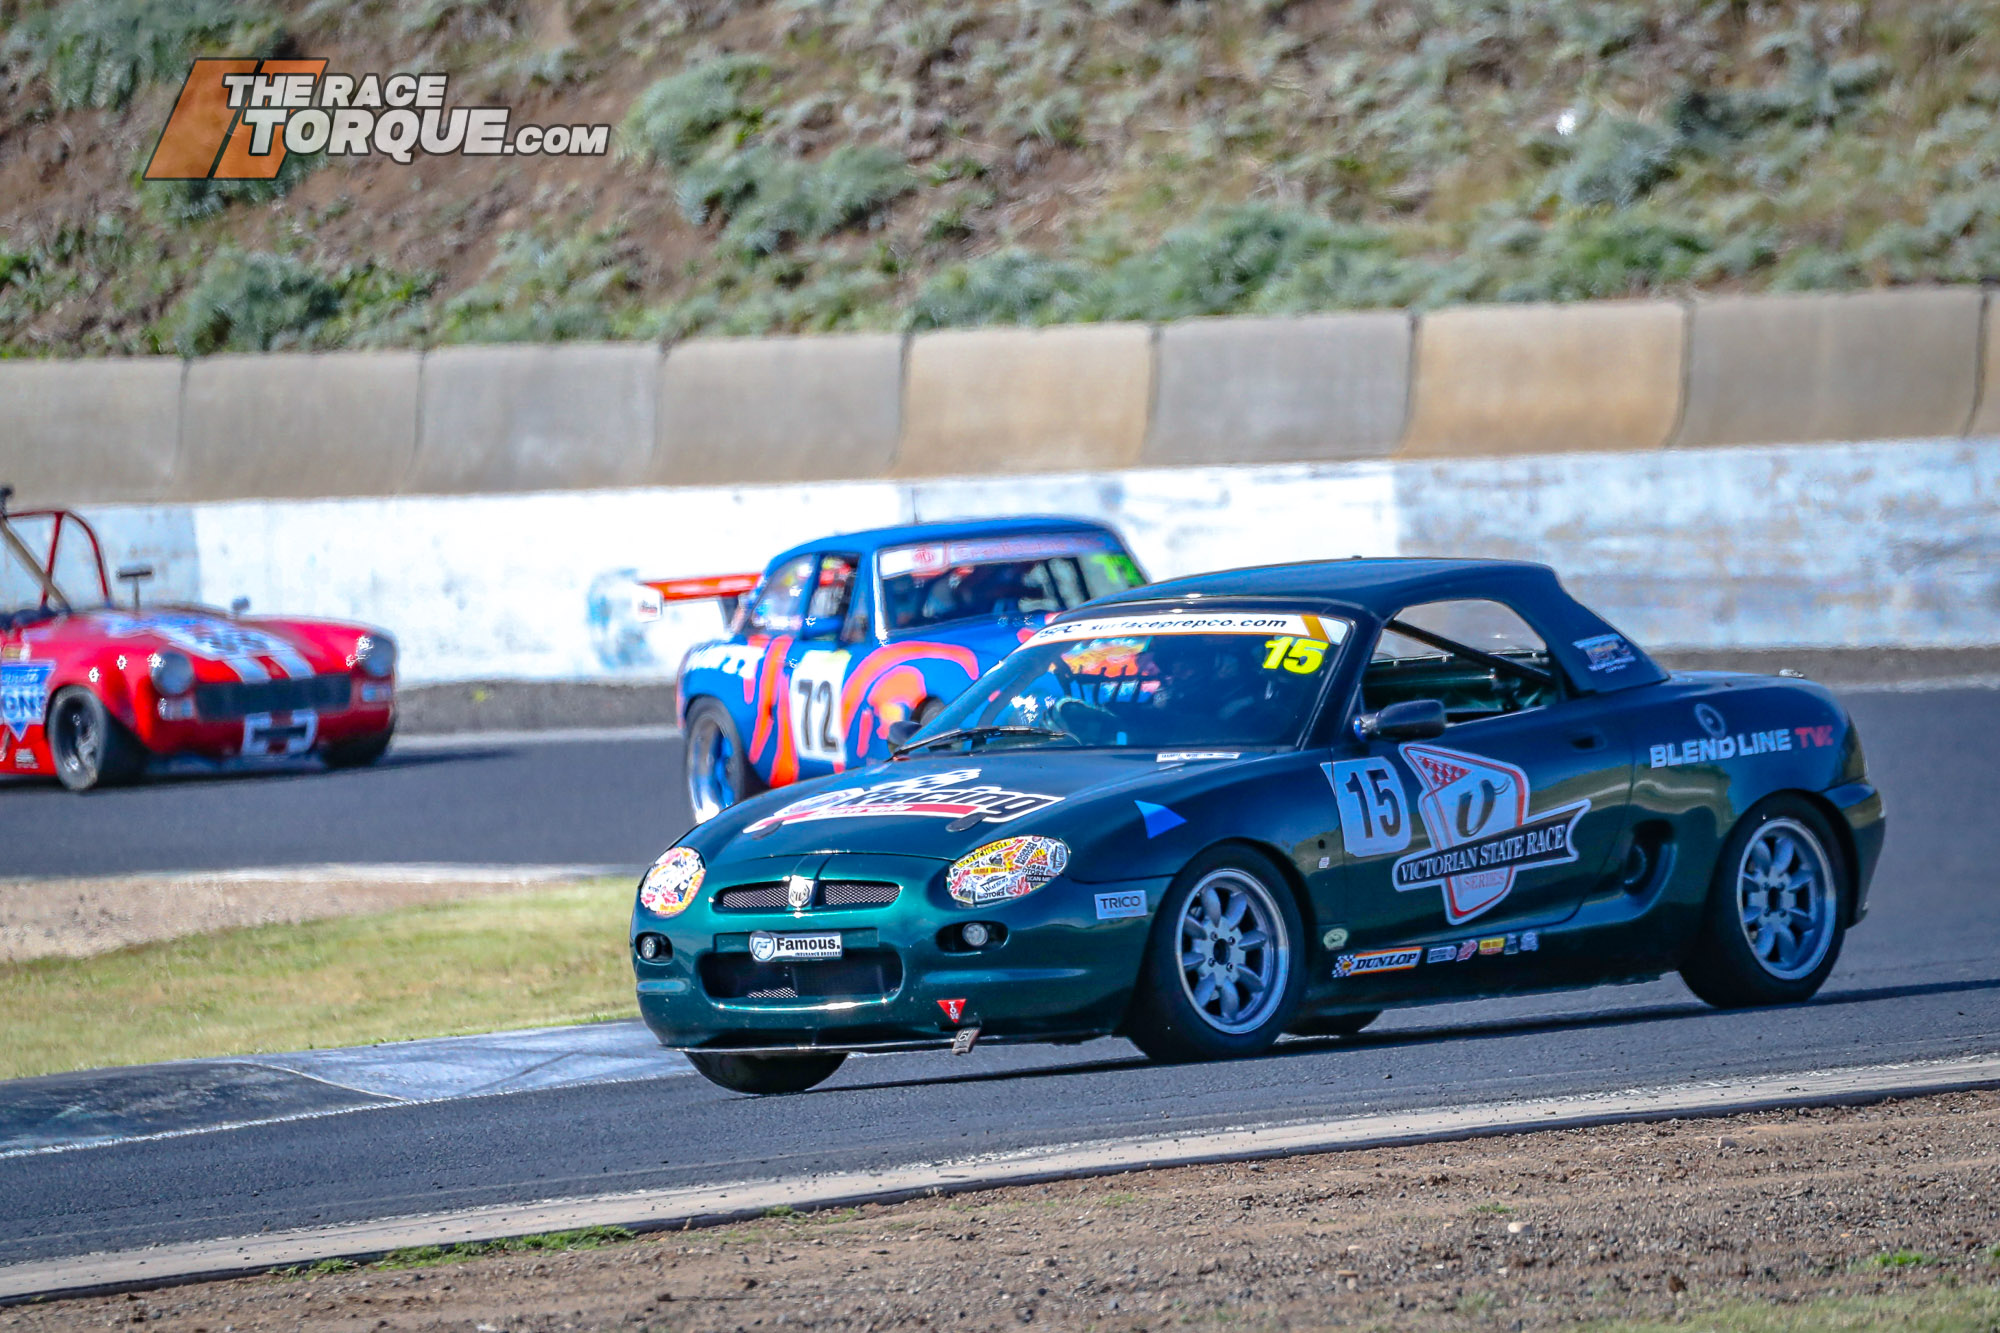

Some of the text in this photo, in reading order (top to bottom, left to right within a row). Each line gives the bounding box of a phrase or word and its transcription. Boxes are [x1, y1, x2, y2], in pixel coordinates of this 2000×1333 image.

[1263, 636, 1329, 674] 15
[798, 680, 838, 752] 72
[1345, 768, 1401, 839] 15
[1401, 823, 1567, 882] VICTORIAN STATE RACE
[1100, 895, 1141, 909] TRICO
[1354, 953, 1418, 970] DUNLOP
